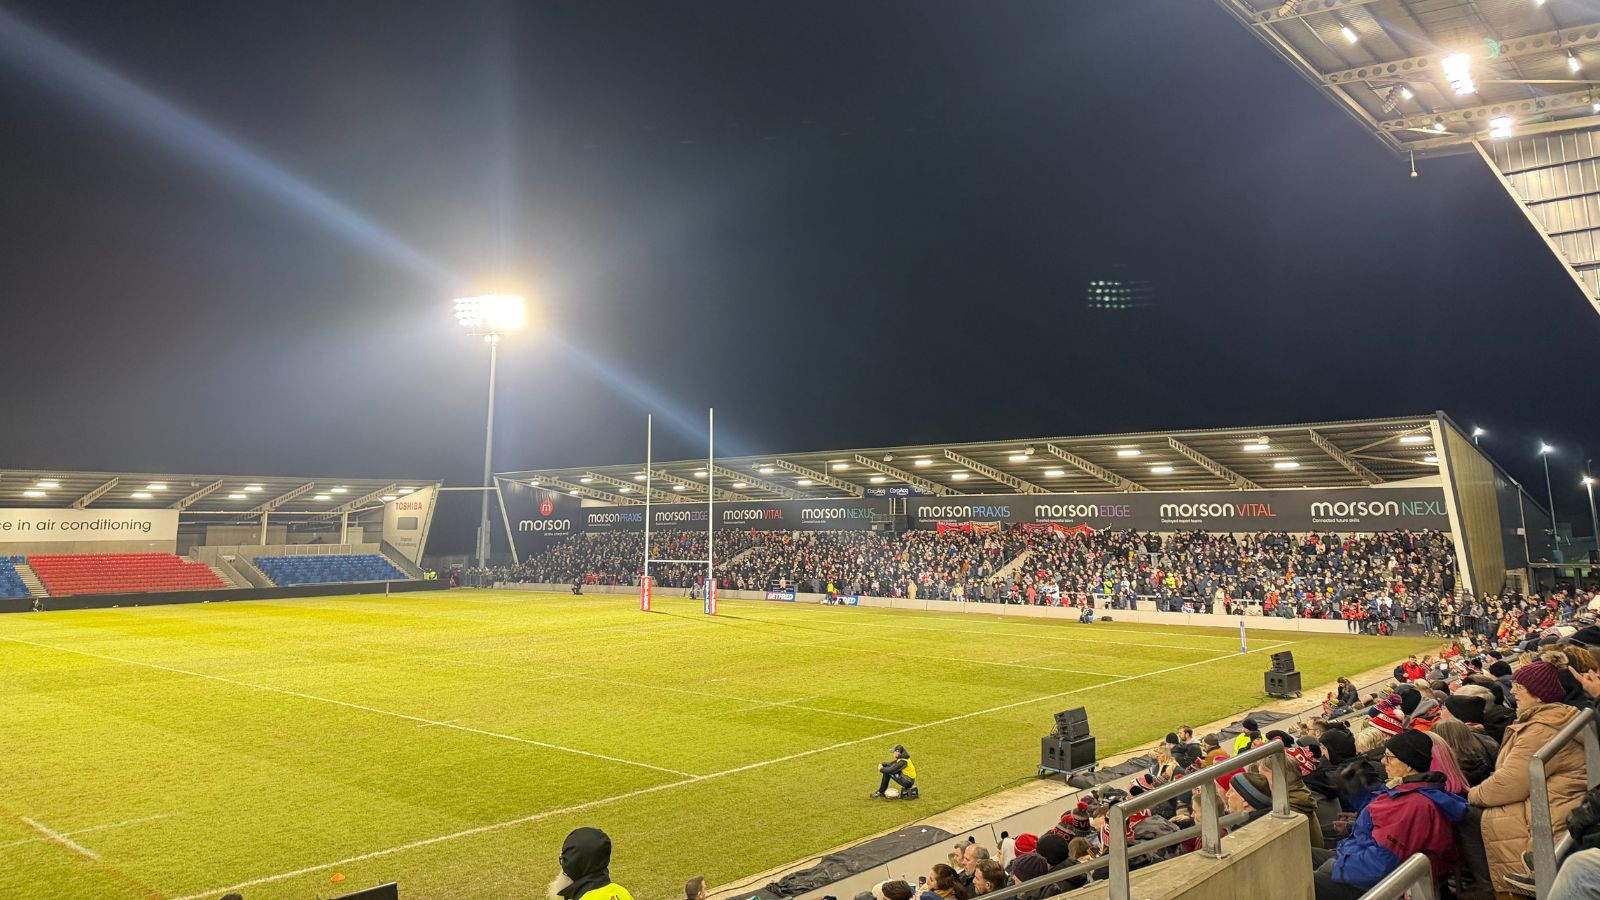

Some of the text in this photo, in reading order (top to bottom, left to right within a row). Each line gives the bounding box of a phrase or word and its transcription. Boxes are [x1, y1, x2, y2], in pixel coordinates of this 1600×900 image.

[395, 502, 423, 511] TOSHIBA
[918, 505, 1011, 518] morson PRAXIS
[1034, 504, 1132, 518] morson EDGE
[1159, 503, 1277, 518] morson VITAL
[1310, 500, 1448, 517] morson NEXU
[588, 512, 643, 523] morson PRAXIS
[655, 510, 709, 521] morson EDGE
[723, 509, 783, 520] morson VITAL
[801, 507, 846, 519] morson
[17, 519, 31, 531] in
[36, 519, 56, 531] air
[60, 519, 152, 533] conditioning
[518, 519, 571, 532] morson
[767, 592, 794, 600] BETFRED
